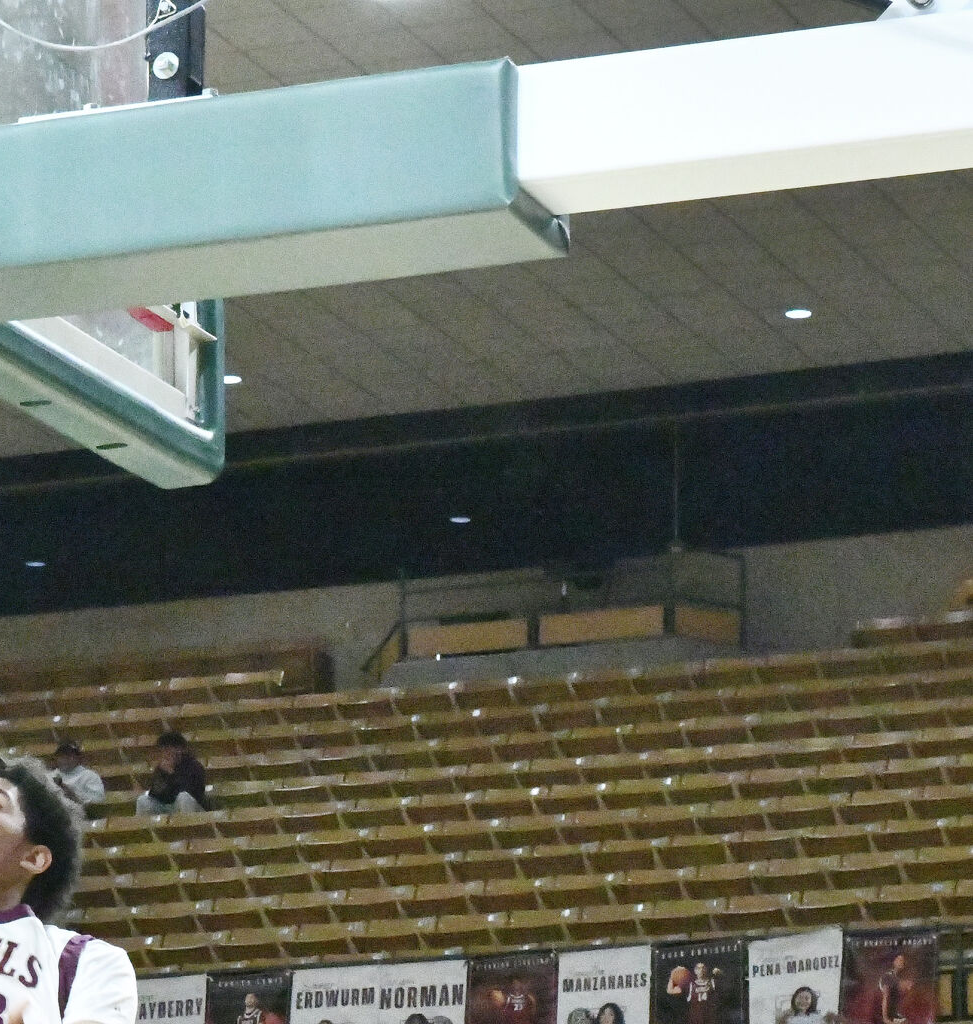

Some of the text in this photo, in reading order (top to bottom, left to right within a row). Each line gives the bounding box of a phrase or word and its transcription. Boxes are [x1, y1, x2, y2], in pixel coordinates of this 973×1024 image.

[786, 955, 840, 974] MARQUEZ
[562, 973, 647, 992] MANZANARES
[296, 984, 464, 1009] ERDWURM NORMAN
[138, 998, 203, 1020] AYBERRY
